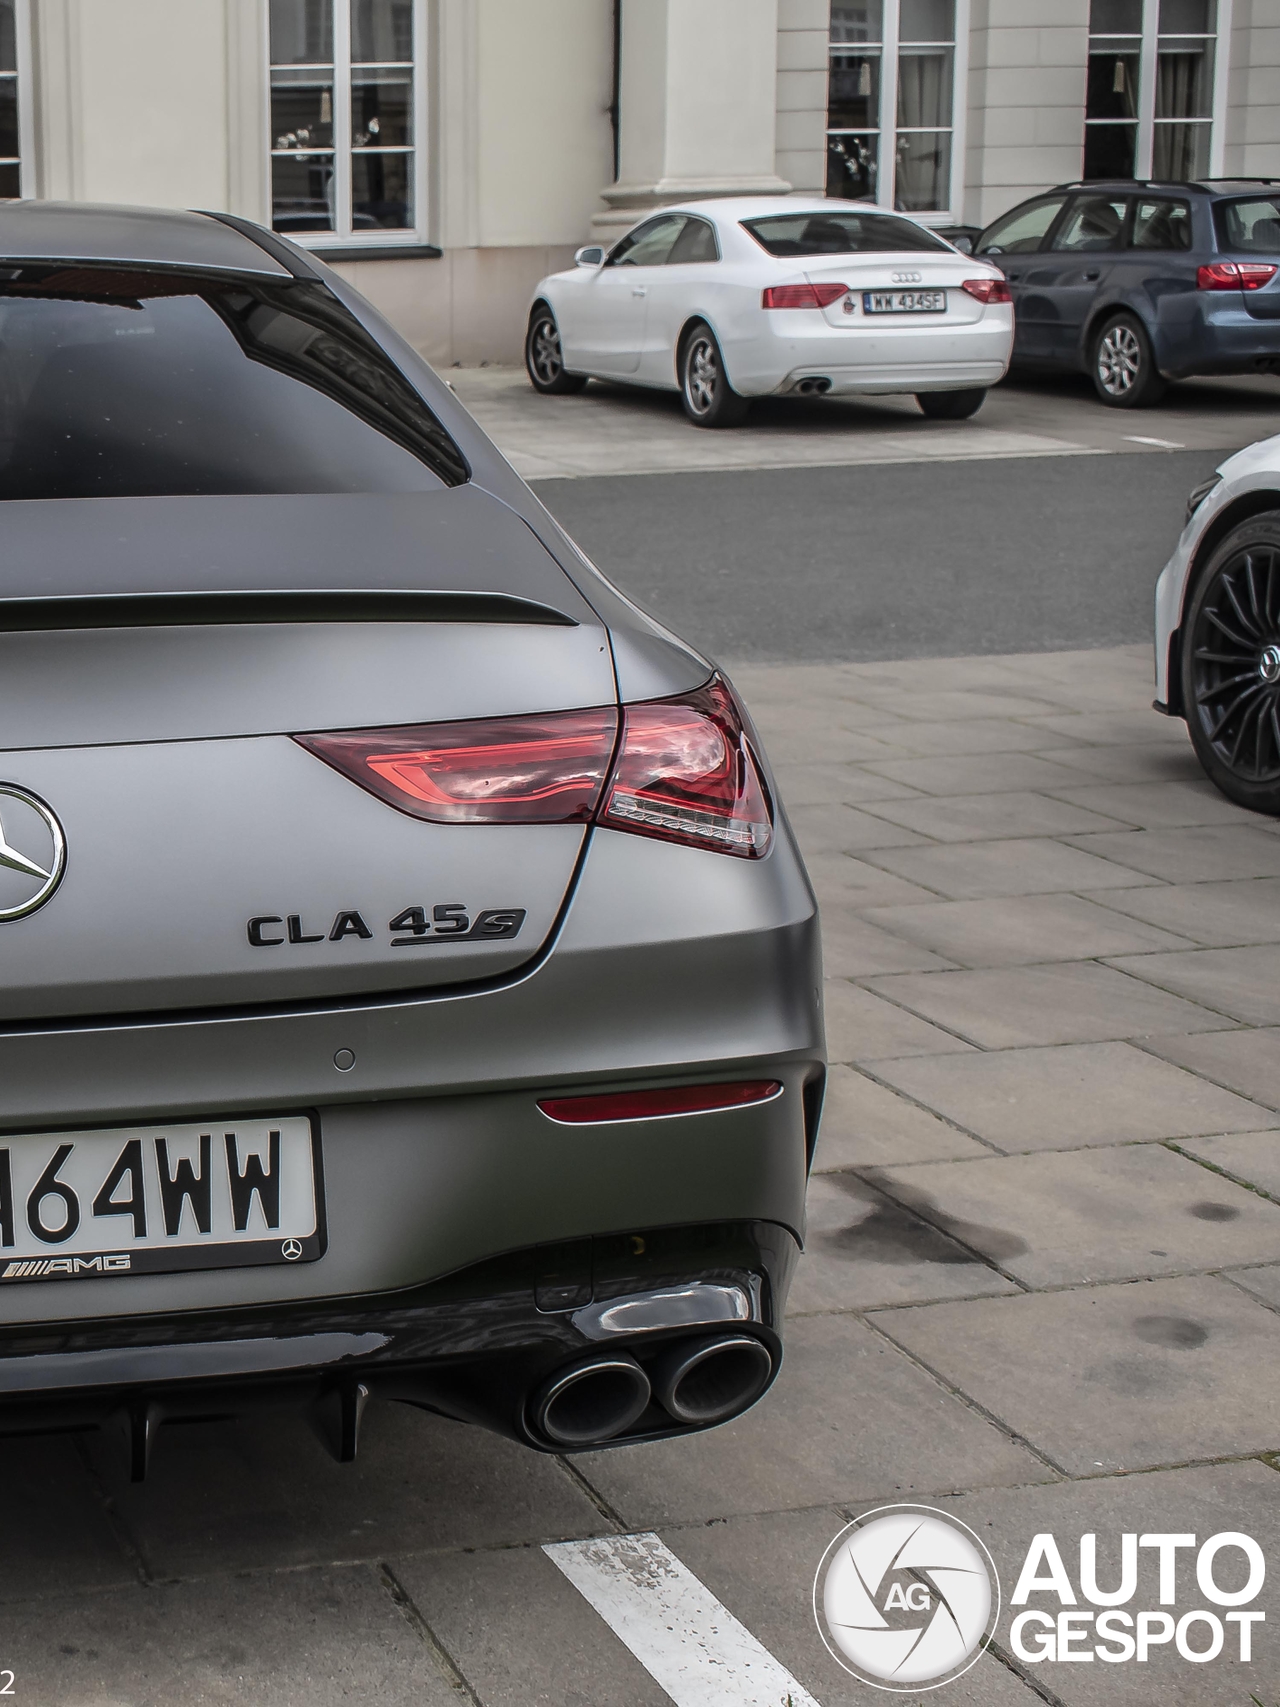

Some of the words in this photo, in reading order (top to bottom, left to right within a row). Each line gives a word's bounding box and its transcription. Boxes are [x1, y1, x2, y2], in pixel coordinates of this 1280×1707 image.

[873, 293, 893, 311] WW
[898, 292, 942, 310] 434SF
[246, 908, 374, 948] CLA
[44, 1252, 132, 1275] AMG
